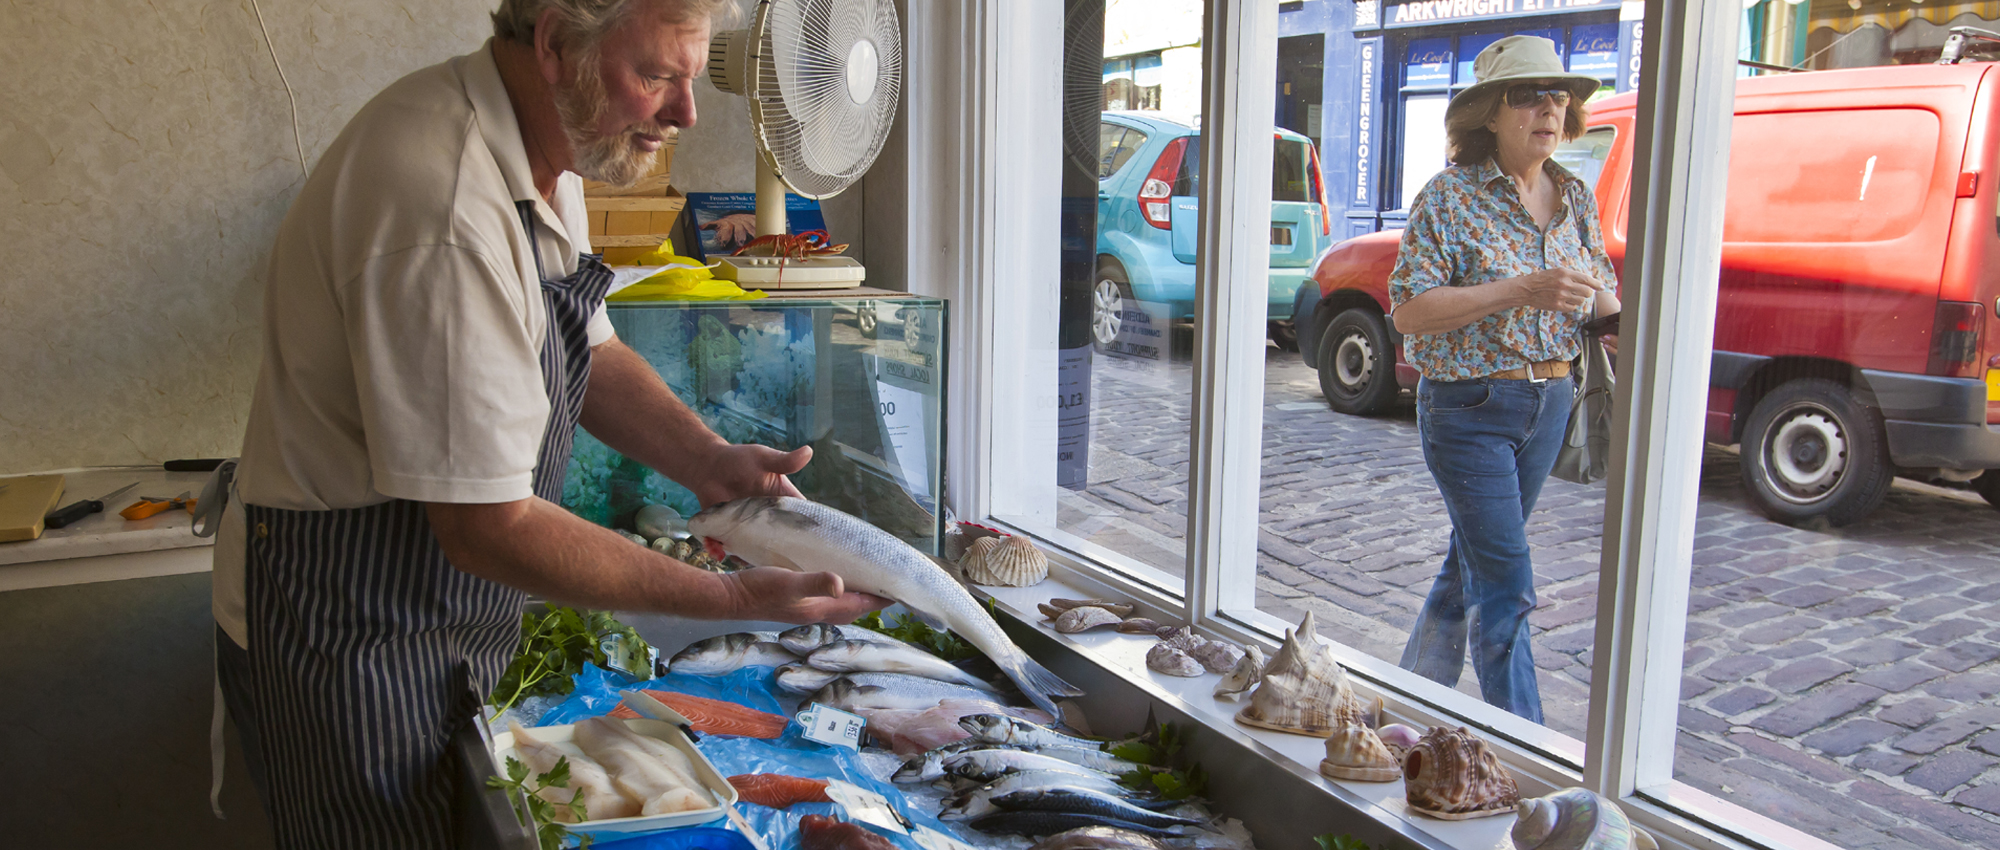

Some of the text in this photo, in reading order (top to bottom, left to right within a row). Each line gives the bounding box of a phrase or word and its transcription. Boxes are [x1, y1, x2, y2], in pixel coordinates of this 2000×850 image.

[1395, 0, 1514, 22] ARKWRIGHT
[1629, 22, 1643, 92] GROC
[1357, 46, 1372, 200] GREENGROCER
